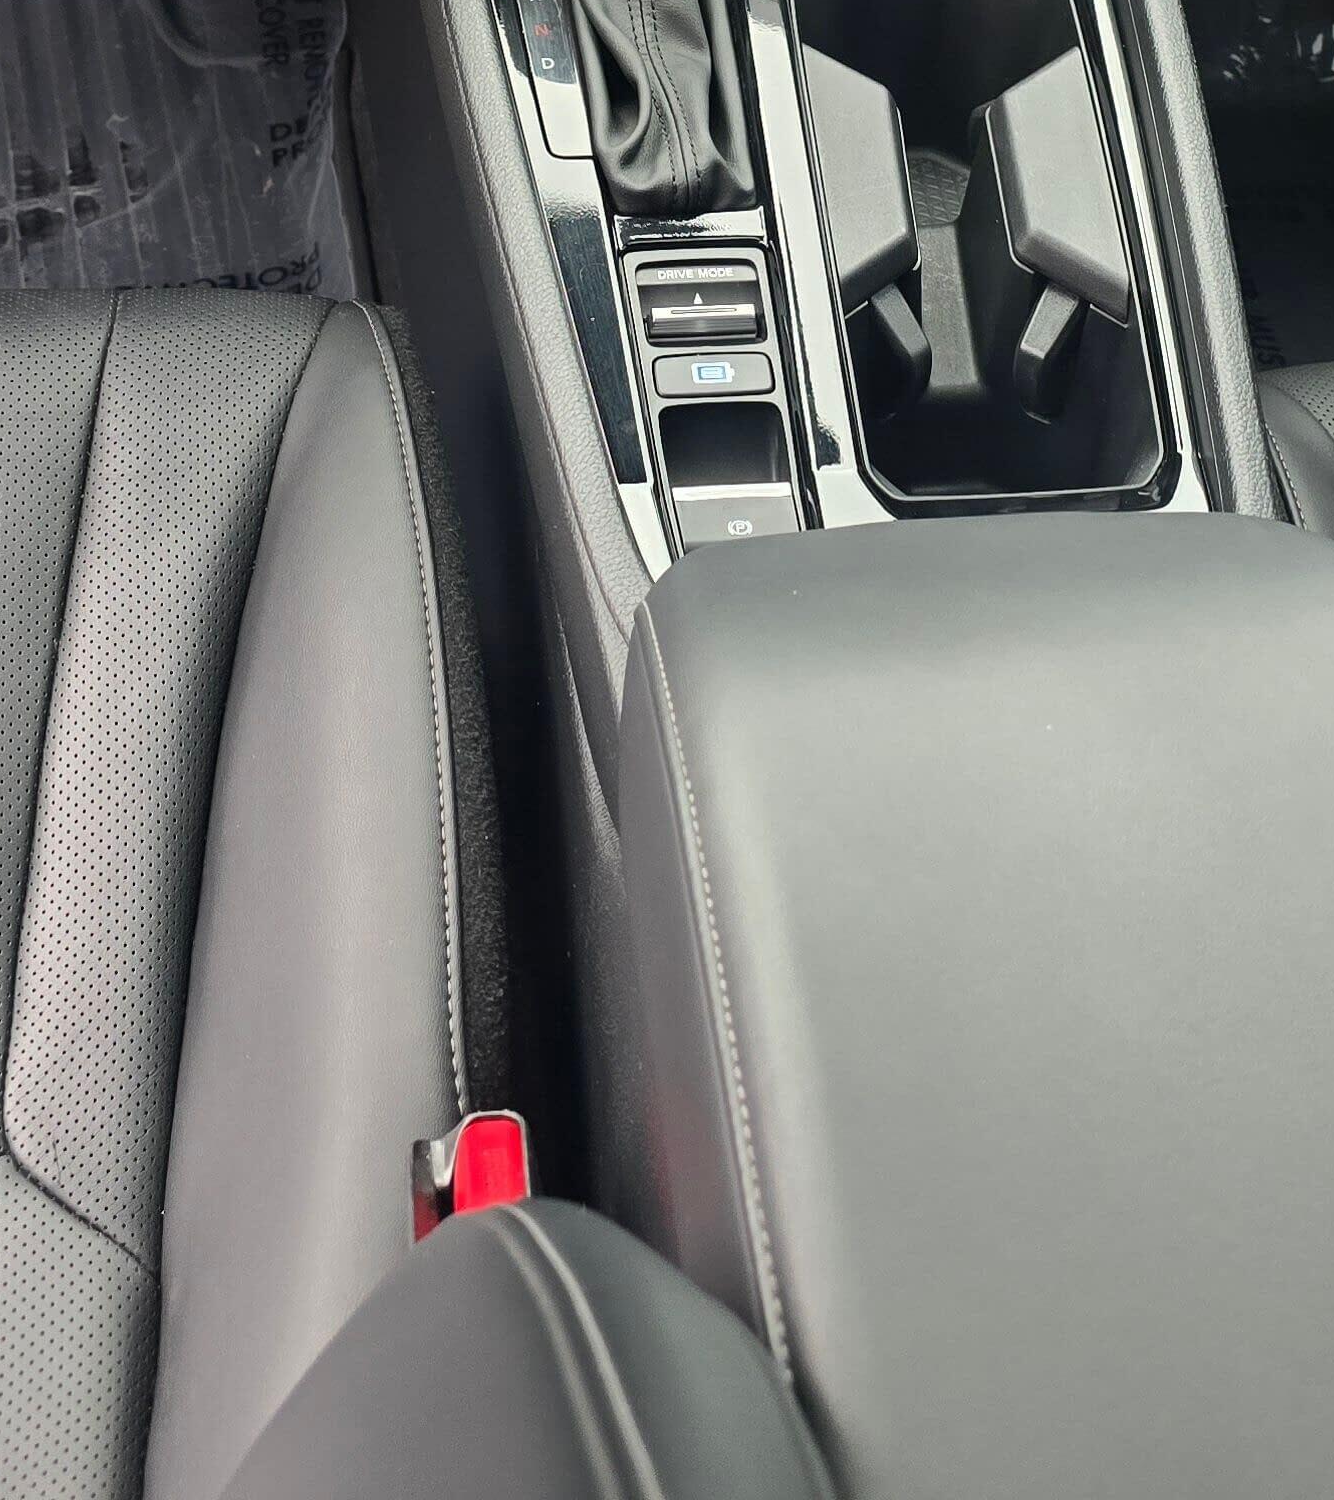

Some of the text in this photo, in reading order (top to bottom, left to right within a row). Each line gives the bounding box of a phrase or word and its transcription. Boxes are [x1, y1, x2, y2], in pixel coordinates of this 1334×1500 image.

[534, 24, 551, 38] N
[540, 57, 555, 70] D
[657, 266, 735, 281] DRIVE MODE
